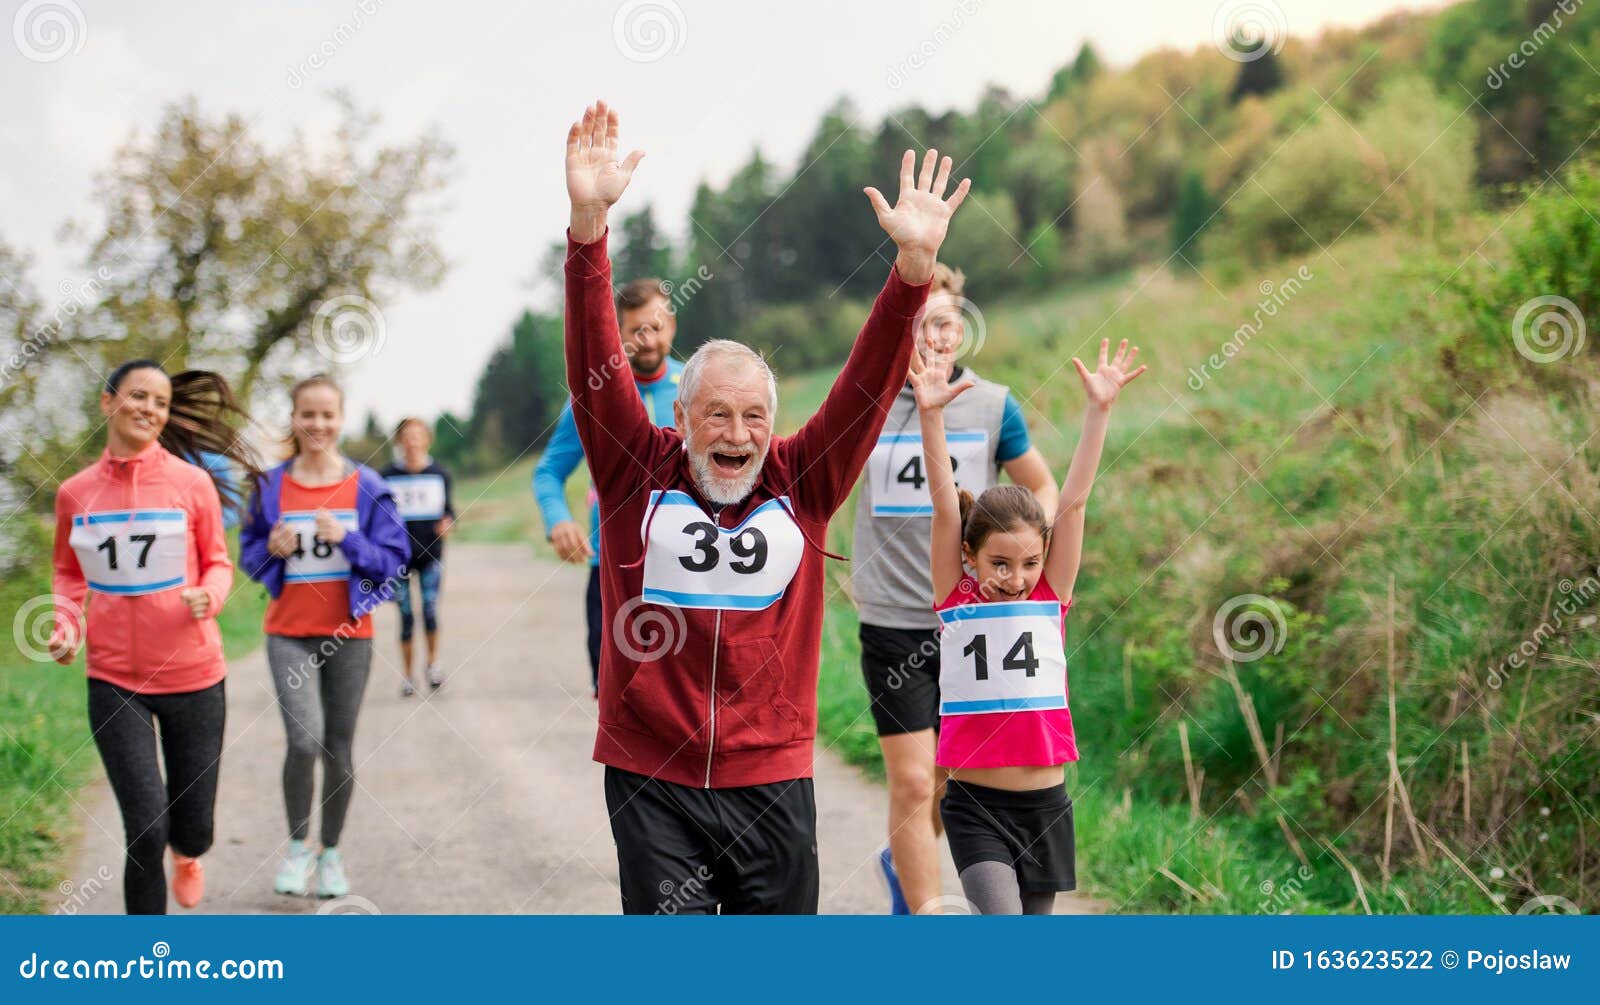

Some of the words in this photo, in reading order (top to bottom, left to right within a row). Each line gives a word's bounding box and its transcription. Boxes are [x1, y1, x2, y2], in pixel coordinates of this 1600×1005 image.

[98, 534, 156, 570] 17
[678, 521, 768, 574] 39
[963, 631, 1039, 681] 14
